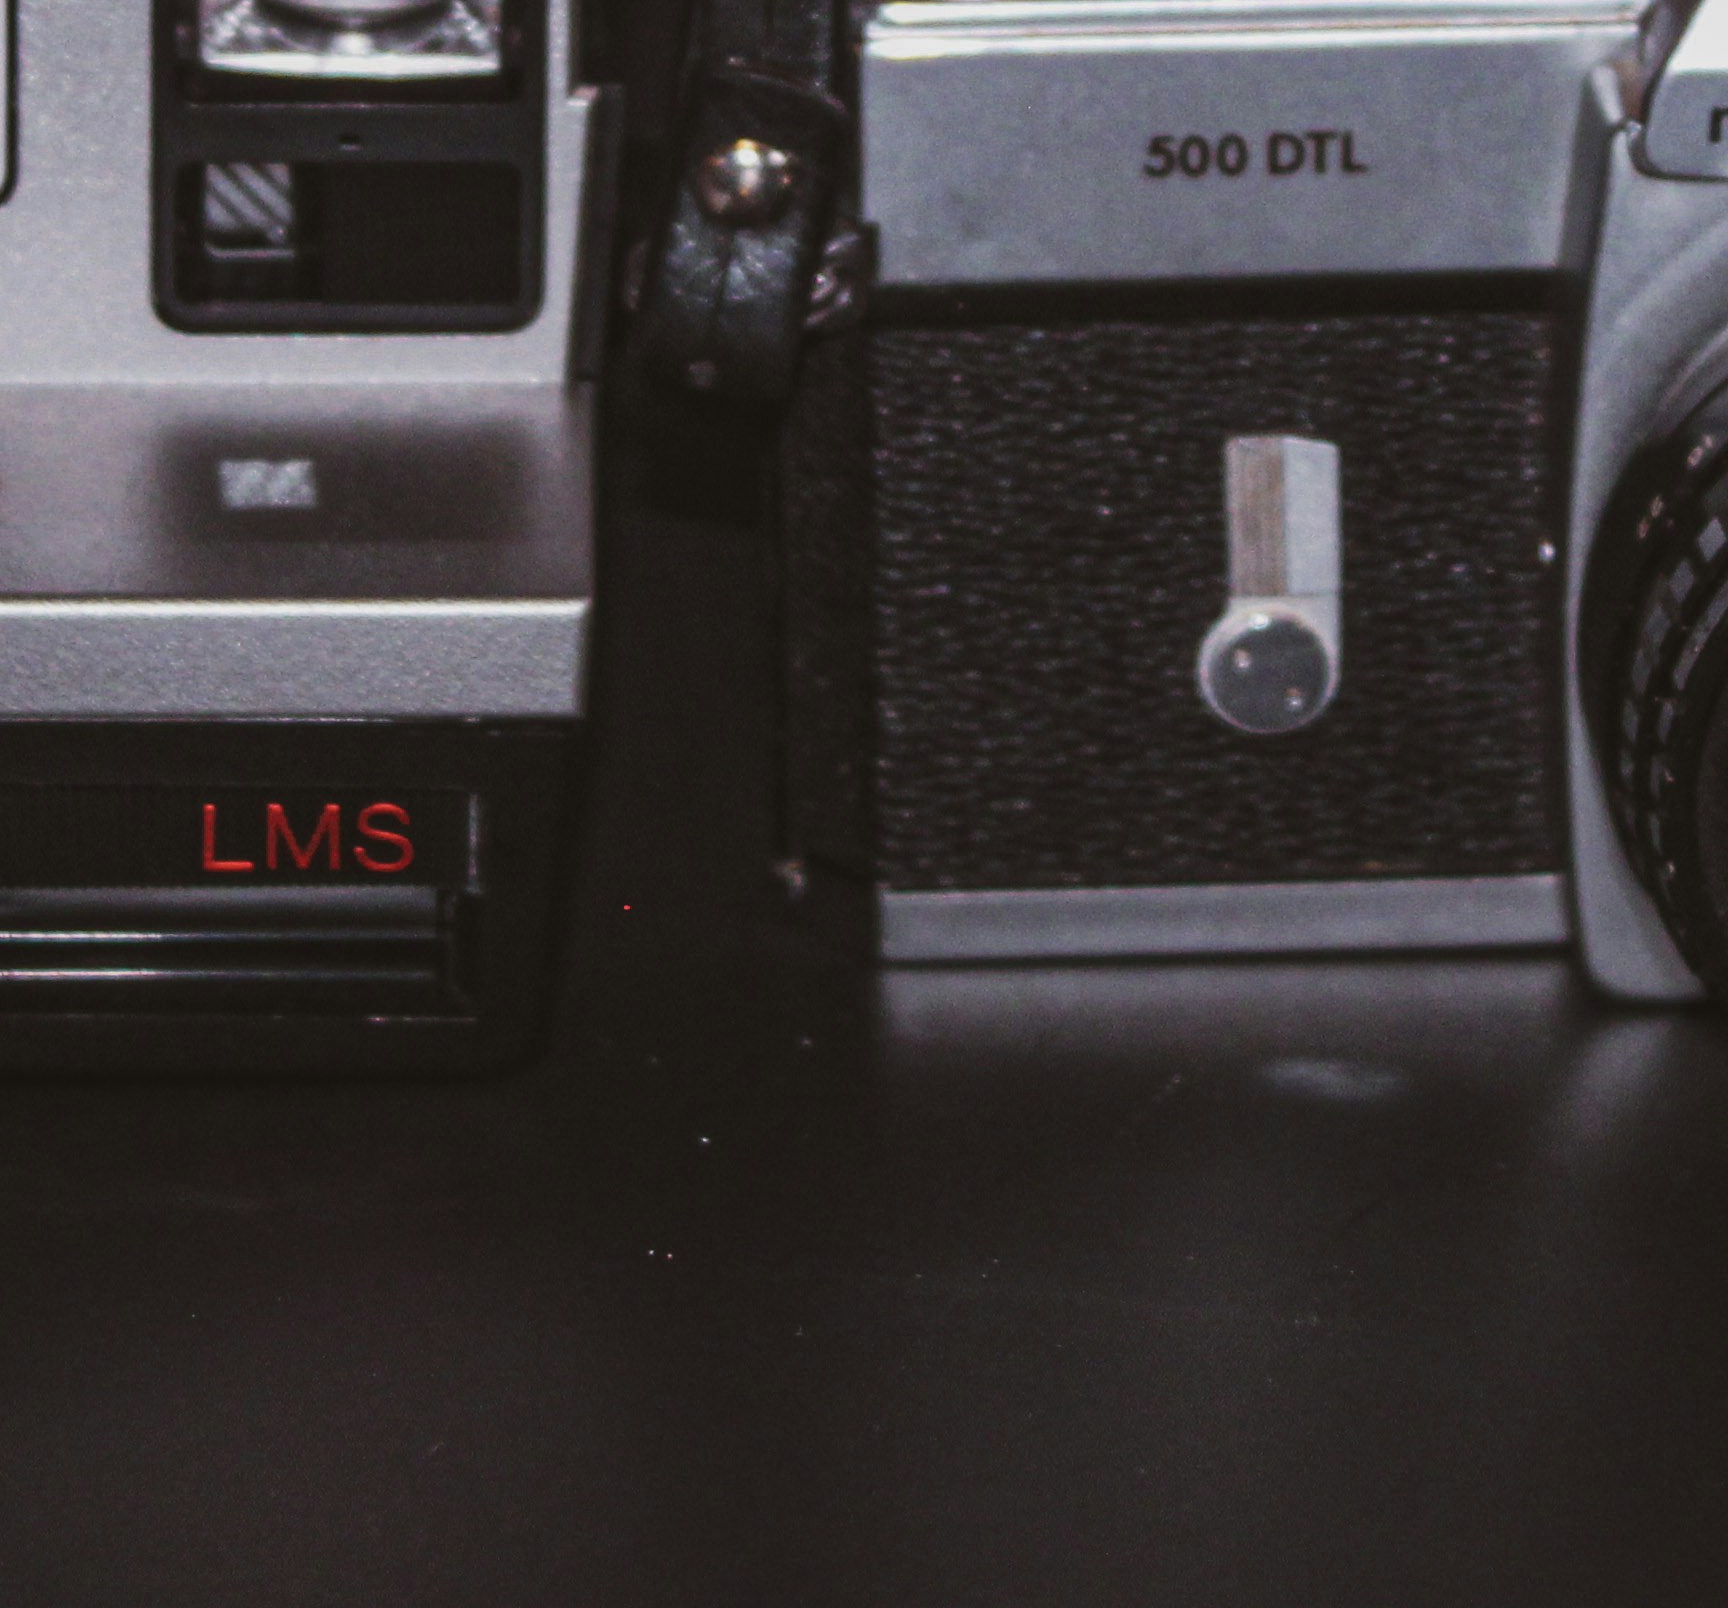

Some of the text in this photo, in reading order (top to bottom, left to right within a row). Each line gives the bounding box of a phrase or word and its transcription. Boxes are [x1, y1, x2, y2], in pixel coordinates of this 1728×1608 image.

[1143, 130, 1369, 179] 500 DTL
[201, 801, 415, 874] LMS
